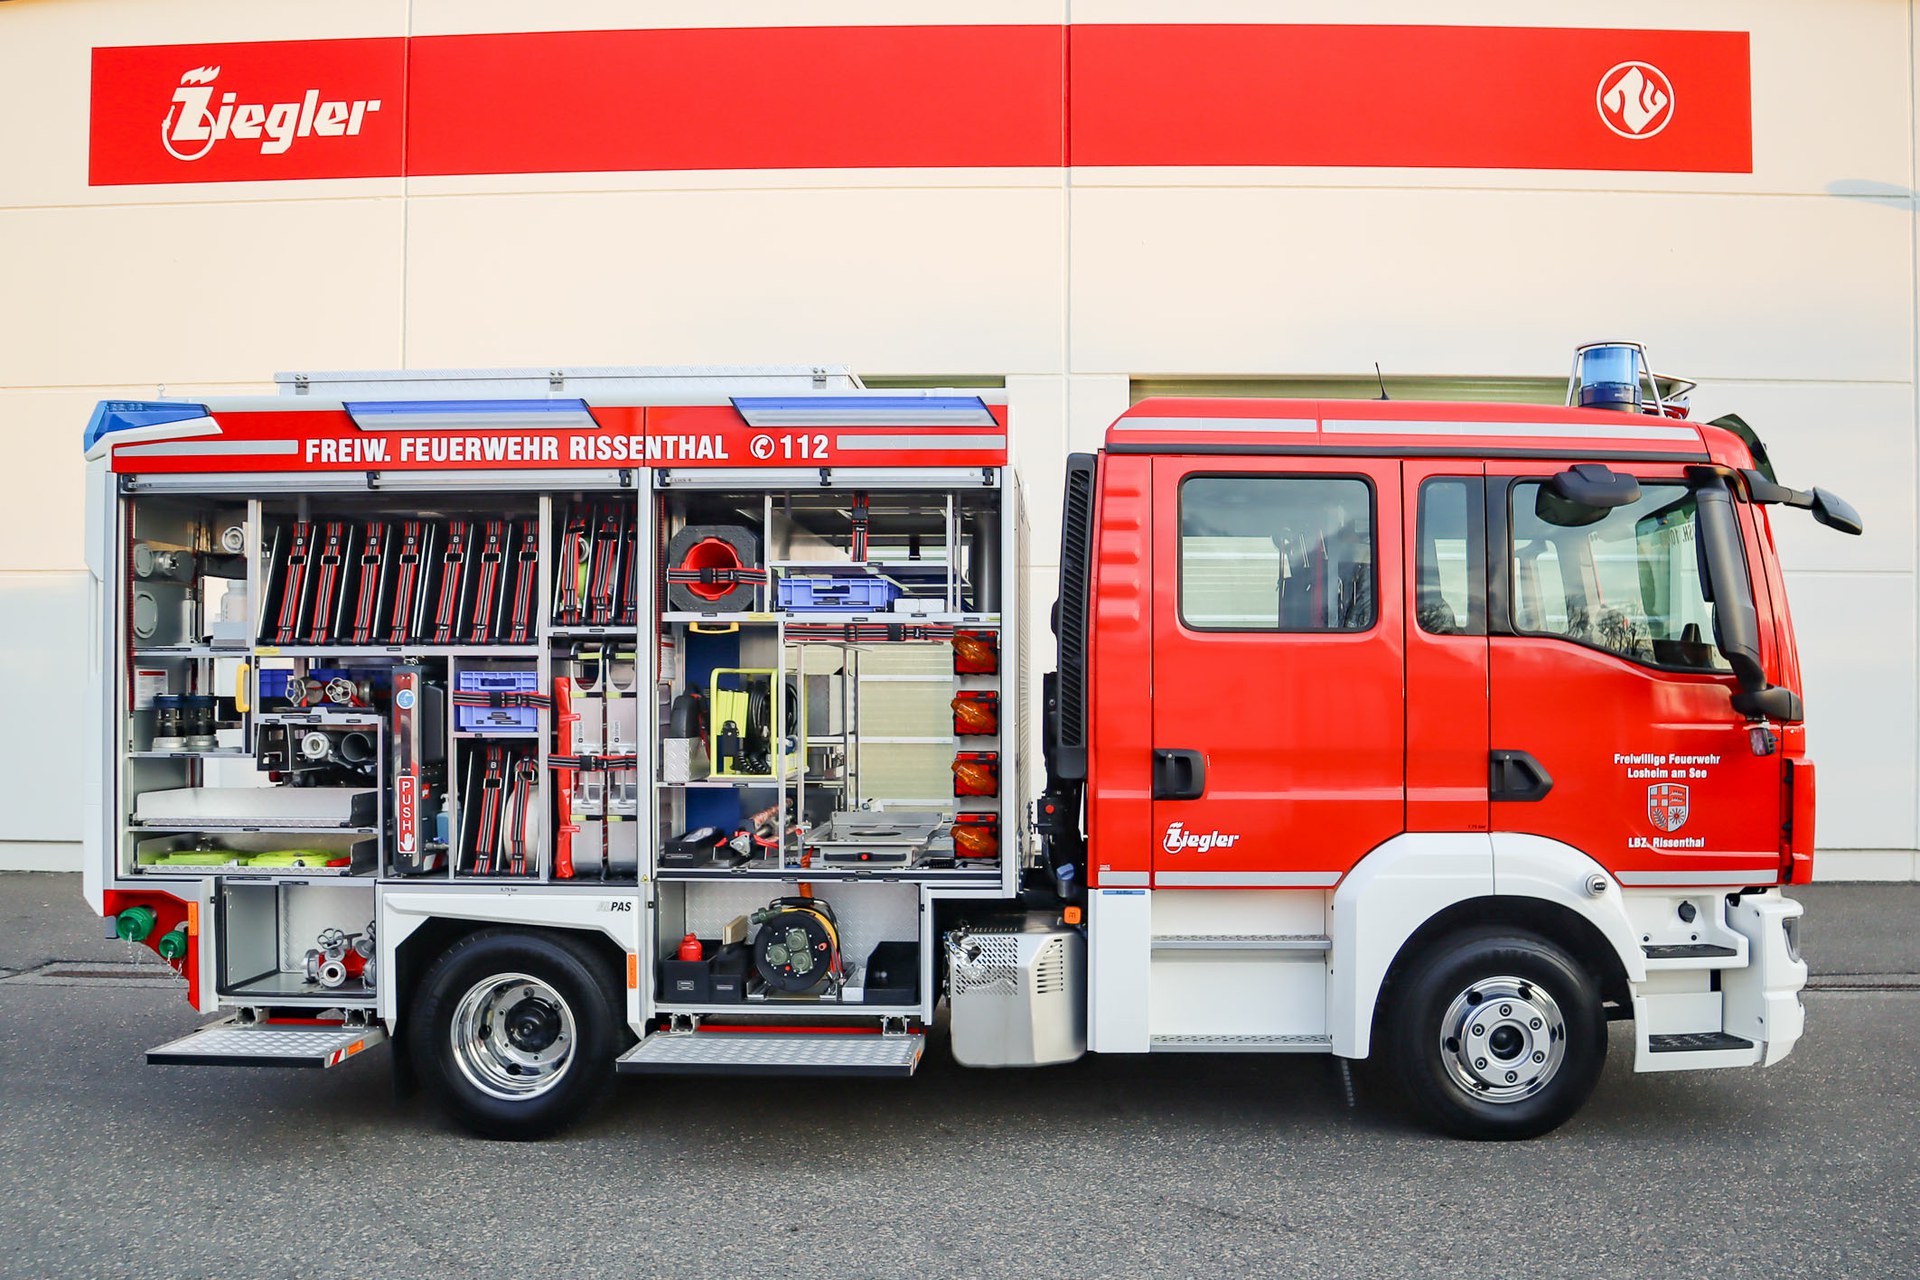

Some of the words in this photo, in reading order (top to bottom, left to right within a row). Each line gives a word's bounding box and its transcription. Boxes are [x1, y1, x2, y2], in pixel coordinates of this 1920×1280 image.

[162, 66, 381, 161] Ziegler
[305, 438, 391, 463] FREIW.
[399, 436, 560, 462] FEUERWEHR
[569, 435, 729, 461] RISSENTHAL
[779, 434, 829, 460] 112
[1614, 753, 1666, 766] Freiwillige
[1668, 753, 1721, 765] Feuerwehr
[1627, 767, 1669, 779] Losheim
[1671, 769, 1687, 778] am
[1689, 767, 1708, 779] See
[401, 781, 412, 831] PUSH
[1163, 822, 1240, 854] Ziegler
[1653, 837, 1705, 848] Rissenthal
